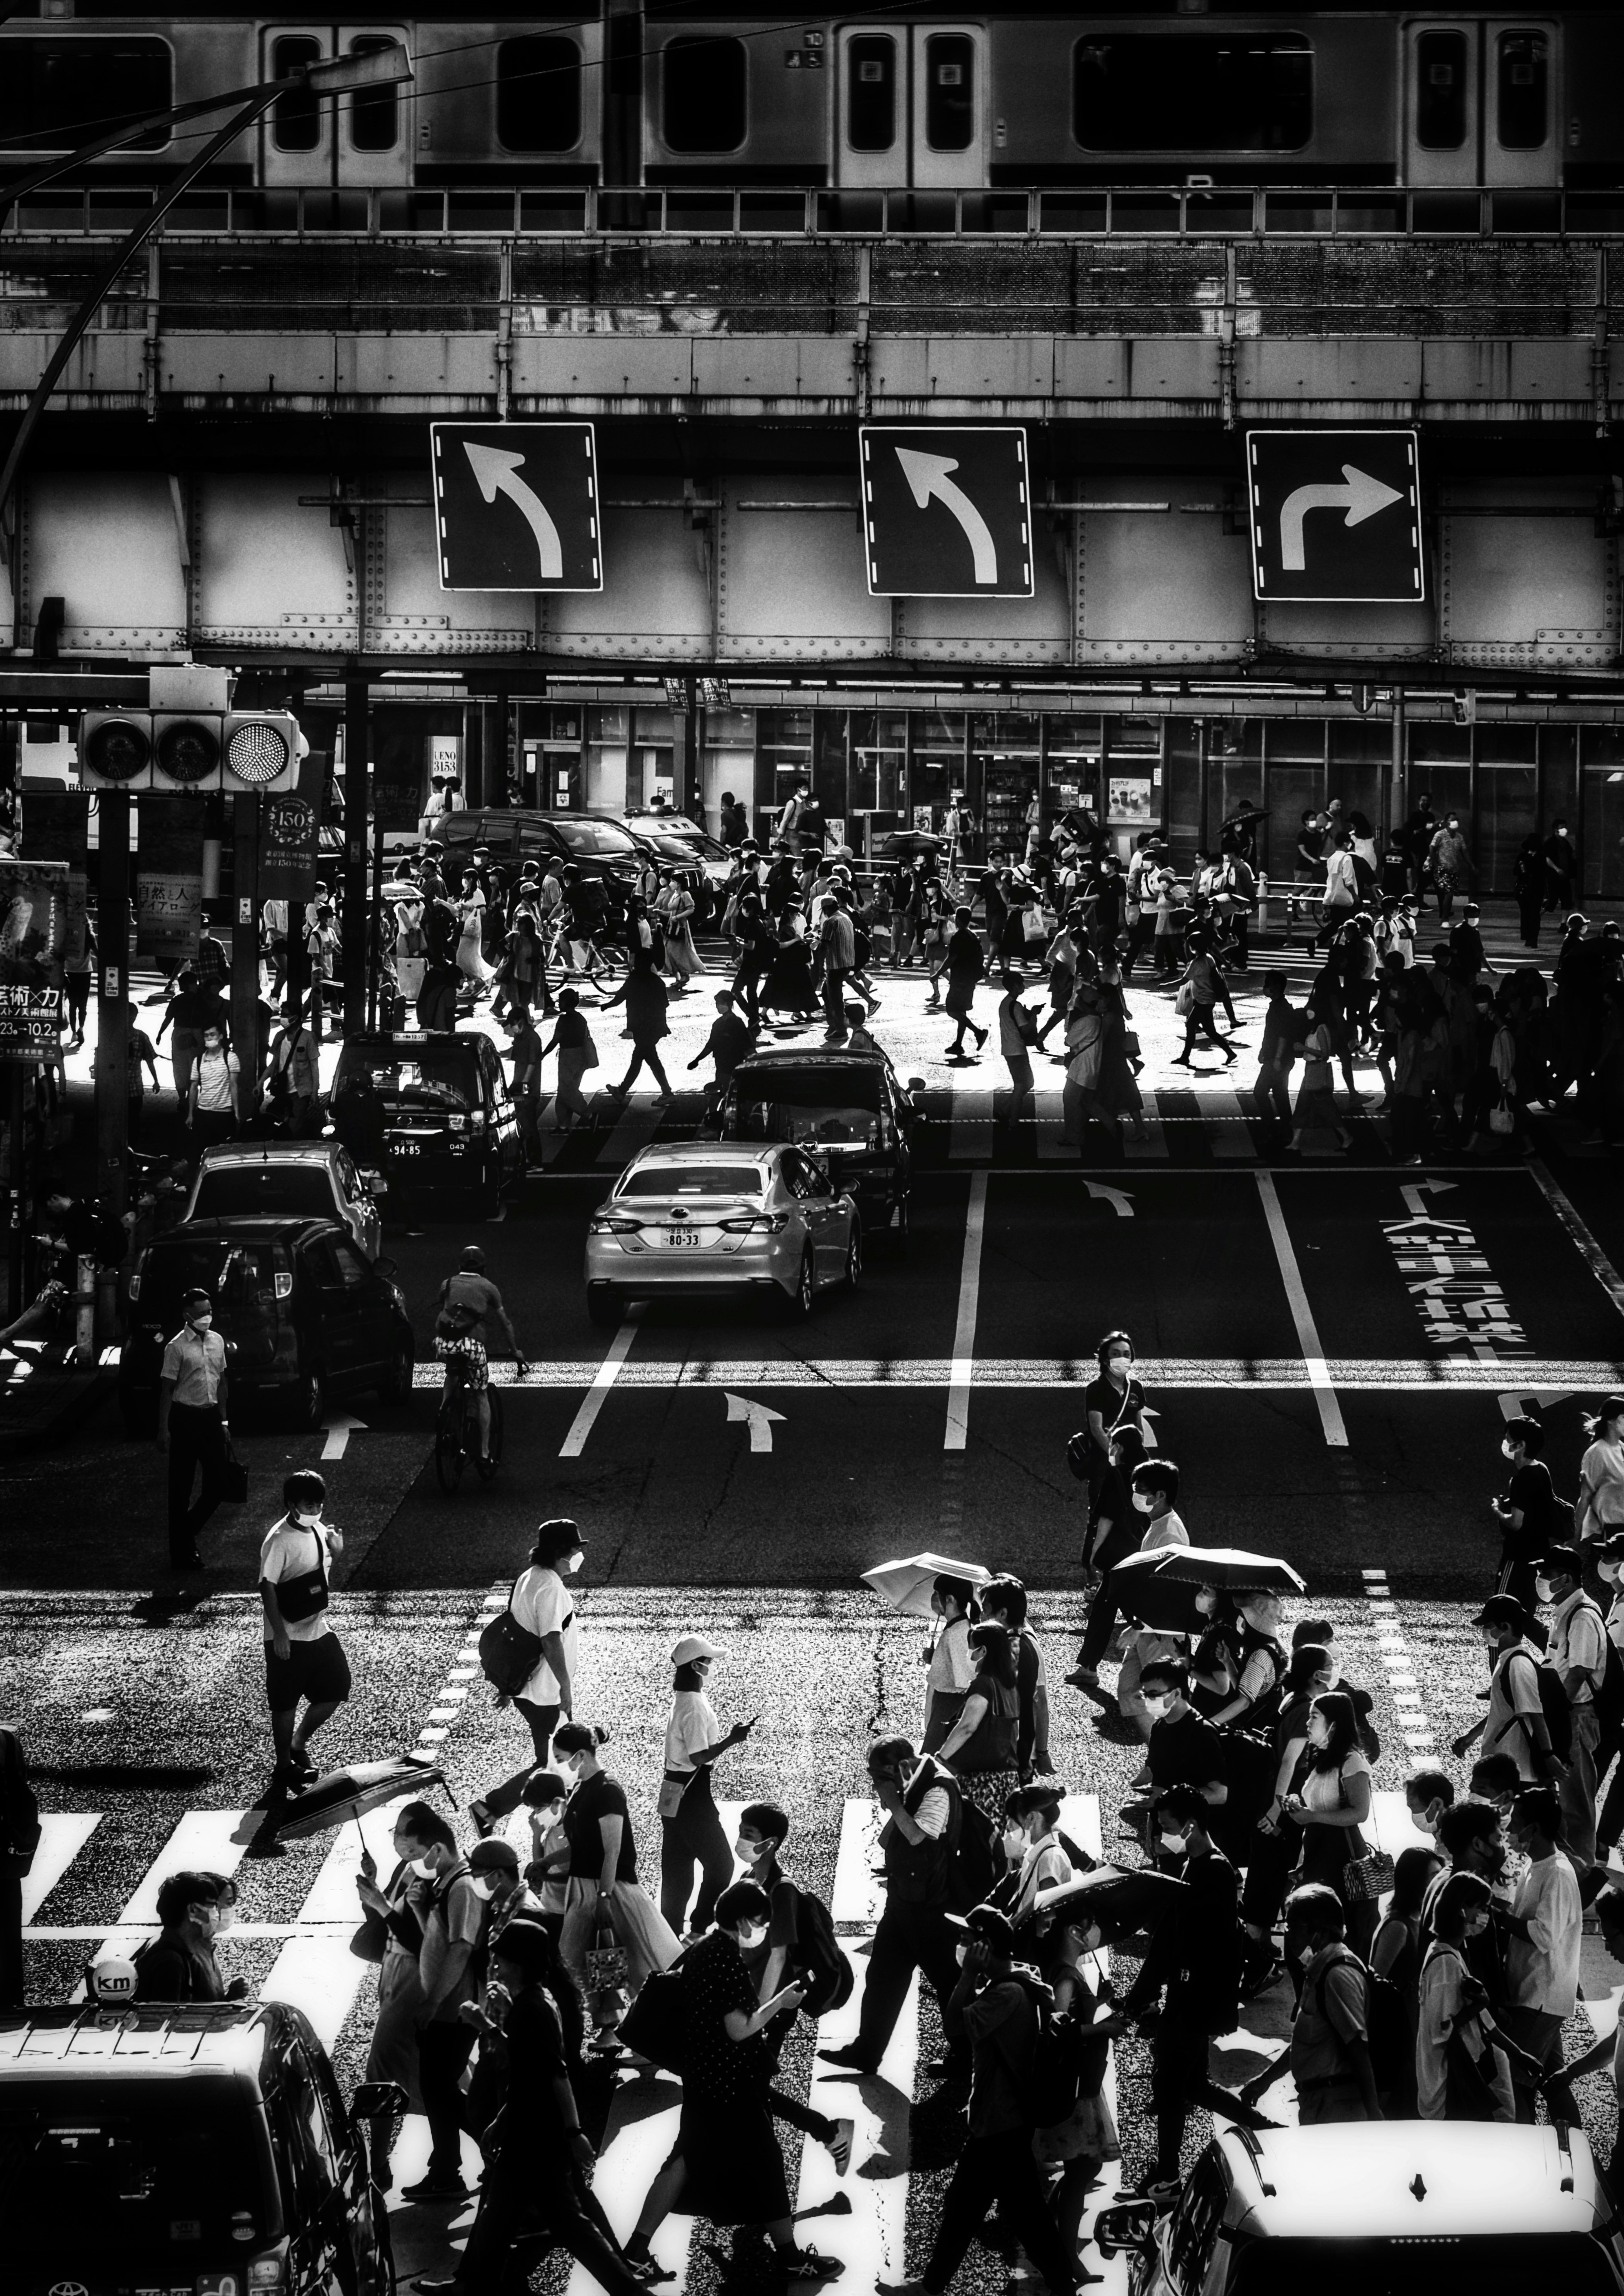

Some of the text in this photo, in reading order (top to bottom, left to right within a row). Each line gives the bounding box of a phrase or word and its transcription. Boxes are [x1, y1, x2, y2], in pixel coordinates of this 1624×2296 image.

[435, 751, 456, 760] UENO
[434, 761, 456, 772] 3153
[279, 812, 305, 827] 150
[266, 850, 312, 860] 東京国立博物館
[265, 859, 311, 869] 創立150年記念
[139, 900, 200, 912] ダイアローグ
[394, 1145, 420, 1155] 94-85
[669, 1235, 699, 1245] 80-33
[98, 1976, 130, 1989] km
